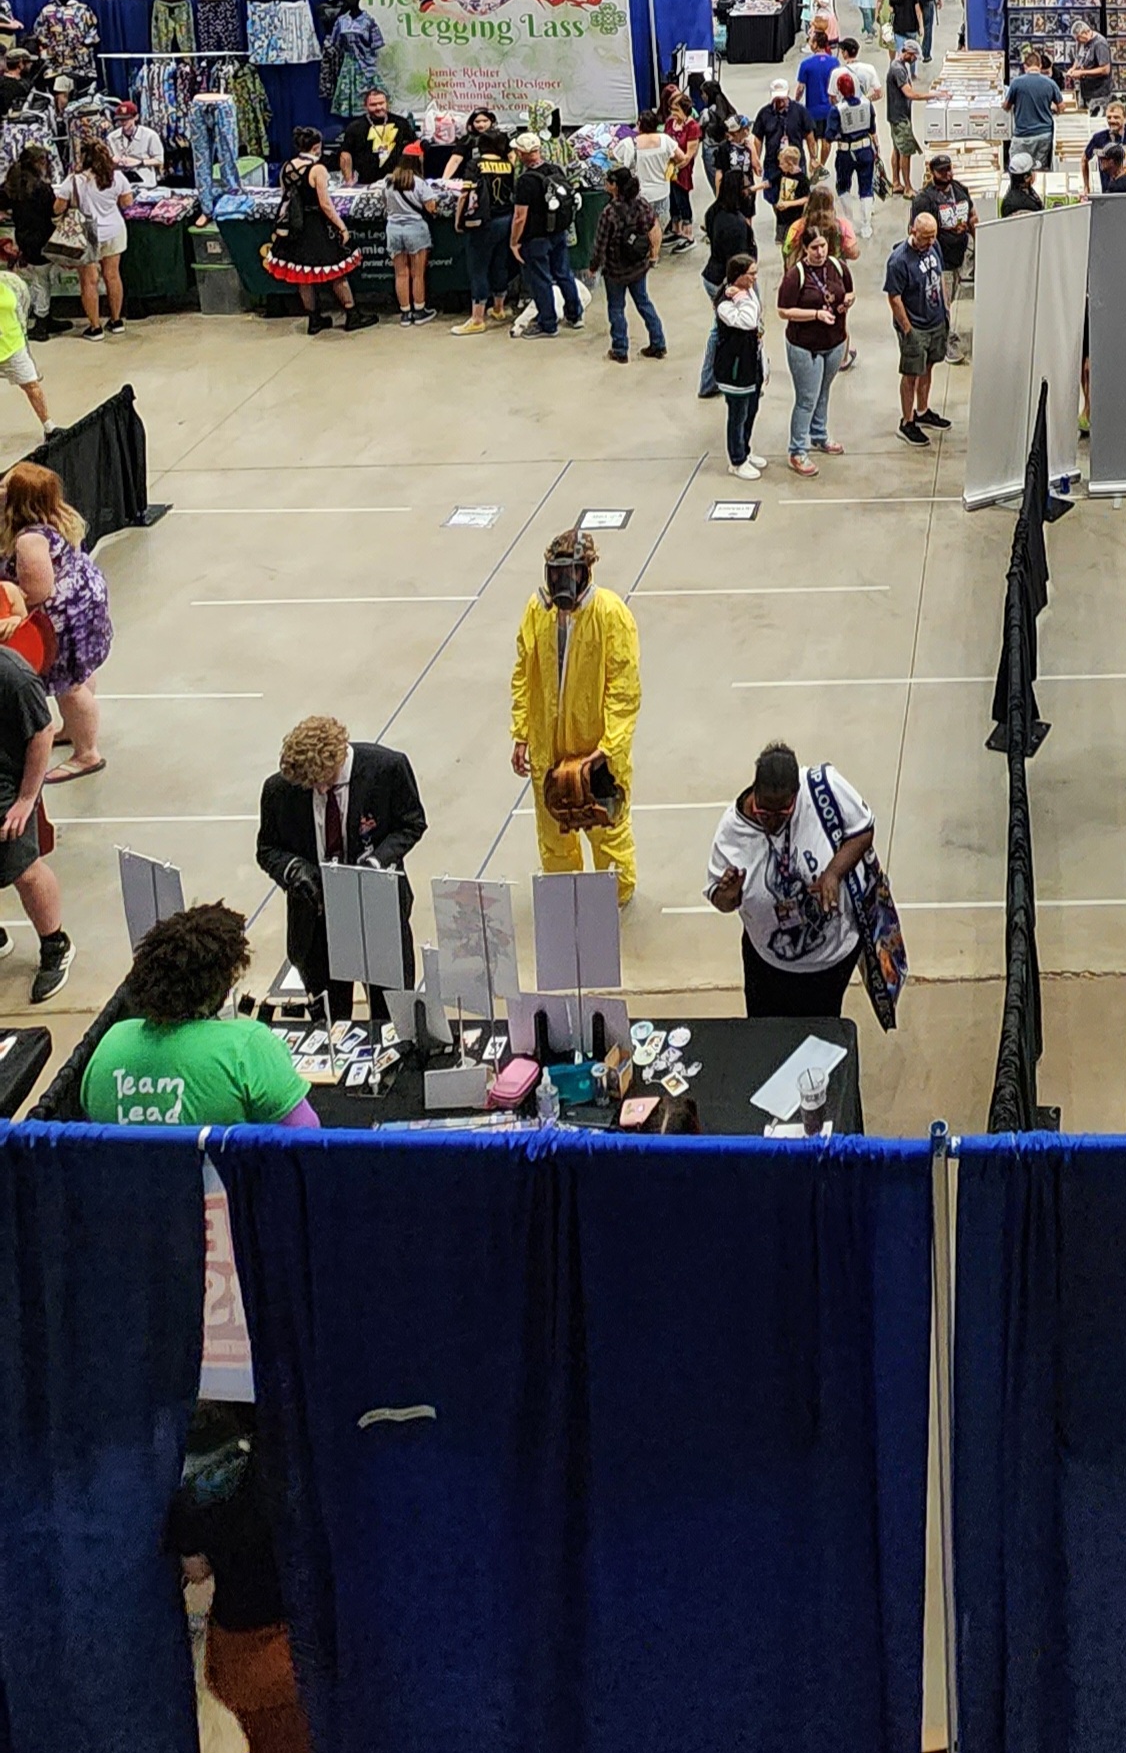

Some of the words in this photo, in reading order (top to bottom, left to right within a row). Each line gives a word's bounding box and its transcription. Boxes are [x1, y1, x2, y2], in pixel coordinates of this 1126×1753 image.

[397, 12, 514, 46] Legging
[519, 13, 586, 39] Lass
[427, 67, 457, 78] Jamie
[459, 67, 500, 79] Richter
[427, 79, 466, 90] Custom
[469, 79, 511, 91] Apparel
[511, 79, 562, 91] Designer
[427, 90, 448, 100] San
[499, 90, 529, 100] Texas
[814, 784, 840, 828] LOOT
[112, 1068, 185, 1100] Team
[117, 1098, 182, 1125] Lead
